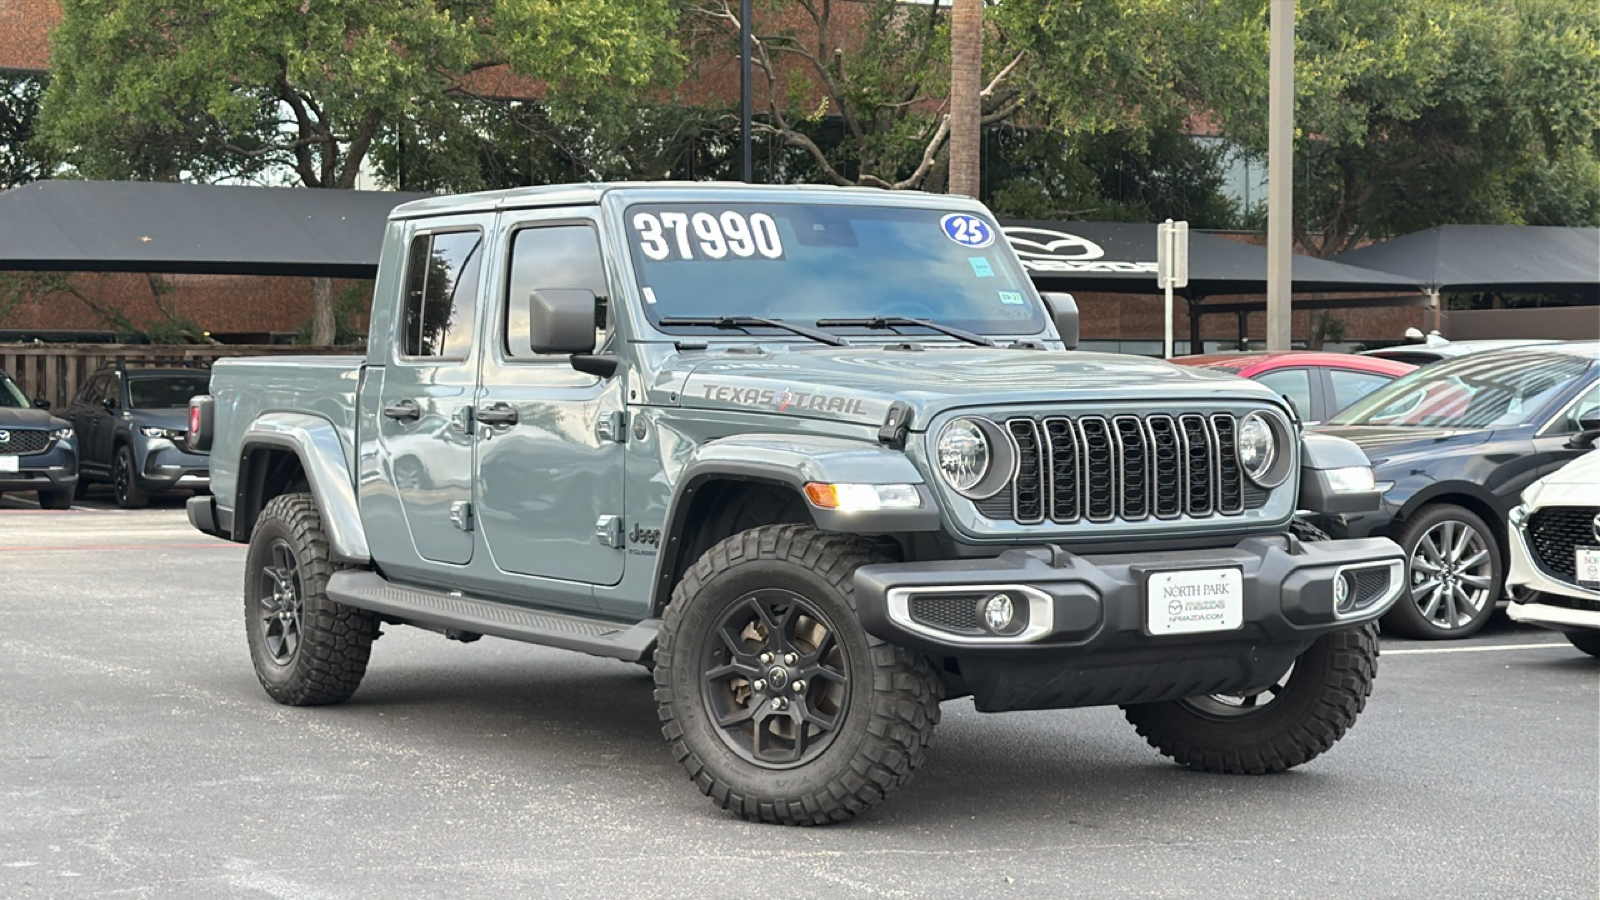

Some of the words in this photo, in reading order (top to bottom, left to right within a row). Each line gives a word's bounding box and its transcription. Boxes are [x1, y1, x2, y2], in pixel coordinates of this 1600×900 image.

[633, 211, 782, 260] 37990
[952, 217, 982, 243] 25
[703, 384, 775, 406] TEXAS
[795, 392, 867, 416] TRAIL
[629, 521, 661, 549] Jeep
[1164, 584, 1200, 598] NORTH
[1203, 583, 1229, 595] PARK
